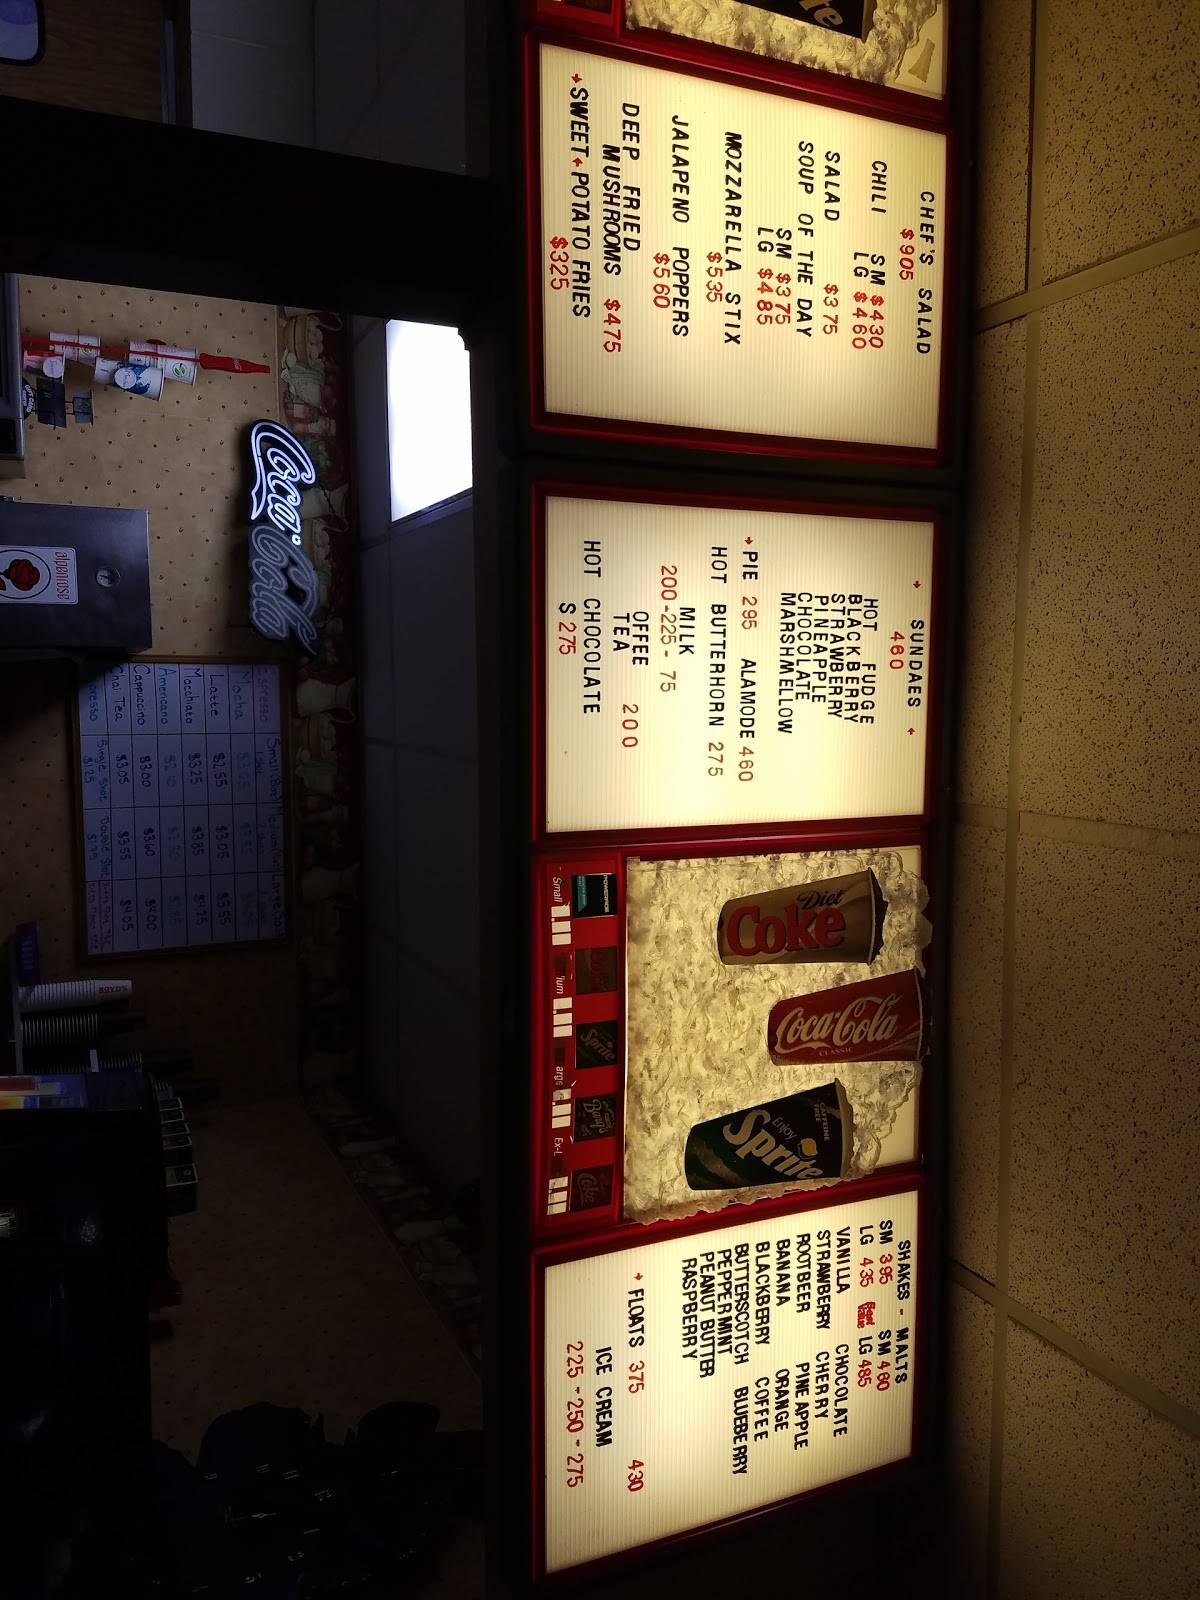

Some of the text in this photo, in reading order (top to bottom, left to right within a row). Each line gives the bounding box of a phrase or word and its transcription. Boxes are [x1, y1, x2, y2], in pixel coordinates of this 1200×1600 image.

[570, 87, 590, 317] SWEET POTATO FRIES
[623, 103, 640, 251] DEEP FRIED
[550, 236, 569, 290] $325
[603, 144, 621, 352] MUSHROOMS $475
[672, 115, 690, 336] JALAPENO POPPERS
[724, 132, 742, 344] MOZZARELLA STIX
[796, 141, 813, 337] SOUP OF THE DAY
[822, 151, 840, 334] SALAD $375
[869, 160, 887, 348] CHILI SM $430
[899, 228, 915, 280] $905
[654, 253, 670, 308] $560
[706, 251, 723, 302] $535
[756, 227, 774, 325] LG $485
[775, 228, 791, 324] SM $375
[852, 252, 869, 349] LG $460
[917, 191, 935, 354] CHEF'S SALAD
[54, 552, 70, 600] alpenrose
[559, 603, 576, 655] S 275
[584, 540, 601, 714] HOT CHOCOLATE
[613, 614, 629, 652] TEA
[632, 611, 649, 666] OFFEE
[679, 607, 695, 655] MILK
[708, 547, 727, 776] HOT BUTTERHORN 275
[738, 551, 758, 782] PIE 295 ALAMODE 460
[778, 593, 795, 734] MARSHMELLOW
[796, 592, 812, 700] CHOCOLATE
[812, 595, 828, 703] PINEAPPLE
[828, 594, 844, 718] STRAWBERRY
[844, 594, 861, 723] BLACKBERRY
[860, 599, 878, 724] HOT FUDGE
[889, 631, 905, 669] 460
[908, 619, 924, 708] SUNDAES
[110, 664, 128, 722] Chai Tea
[134, 664, 151, 726] Cappuccino
[159, 668, 180, 725] Americano
[183, 668, 201, 724] Macchiato
[209, 674, 224, 717] Latte
[231, 670, 250, 720] Mocha
[660, 671, 675, 692] 75
[267, 738, 281, 772] Small
[622, 704, 638, 748] 200
[553, 877, 563, 902] Small
[797, 890, 844, 910] Diet
[726, 903, 847, 957] Coke
[553, 1066, 564, 1086] arge
[578, 1028, 616, 1062] Sprite
[722, 1109, 824, 1180] Sprite
[772, 1116, 798, 1141] Enjoy
[577, 1172, 598, 1205] Coke
[755, 1242, 770, 1345] BLACKBERRY
[776, 1239, 790, 1306] BANANA
[796, 1234, 810, 1313] ROOTBEER
[816, 1230, 830, 1330] STRAWBERRY
[836, 1227, 851, 1293] VANILLA
[859, 1225, 874, 1287] LG 435
[682, 1258, 697, 1360] RASPBERRY
[699, 1252, 714, 1378] PEANUT BUTTER
[717, 1249, 732, 1354] PEPPERMINT
[734, 1243, 749, 1364] BUTTERSCOTCH
[857, 1302, 868, 1328] Value
[866, 1302, 875, 1326] Best
[877, 1220, 893, 1392] SM 395 SM 460
[895, 1240, 910, 1384] SHAKES MALTS
[596, 1347, 612, 1447] ICE CREAM
[628, 1289, 644, 1492] FLOATS 375 430
[774, 1369, 789, 1432] ORANGE
[815, 1352, 829, 1420] CHERRY
[834, 1344, 849, 1437] CHOCOLATE
[858, 1336, 872, 1388] LG 485
[567, 1341, 583, 1488] 225 250 275
[732, 1388, 748, 1475] BLUEBERRY
[754, 1377, 769, 1441] COFFEE
[794, 1363, 809, 1450] PINEAPPLE
